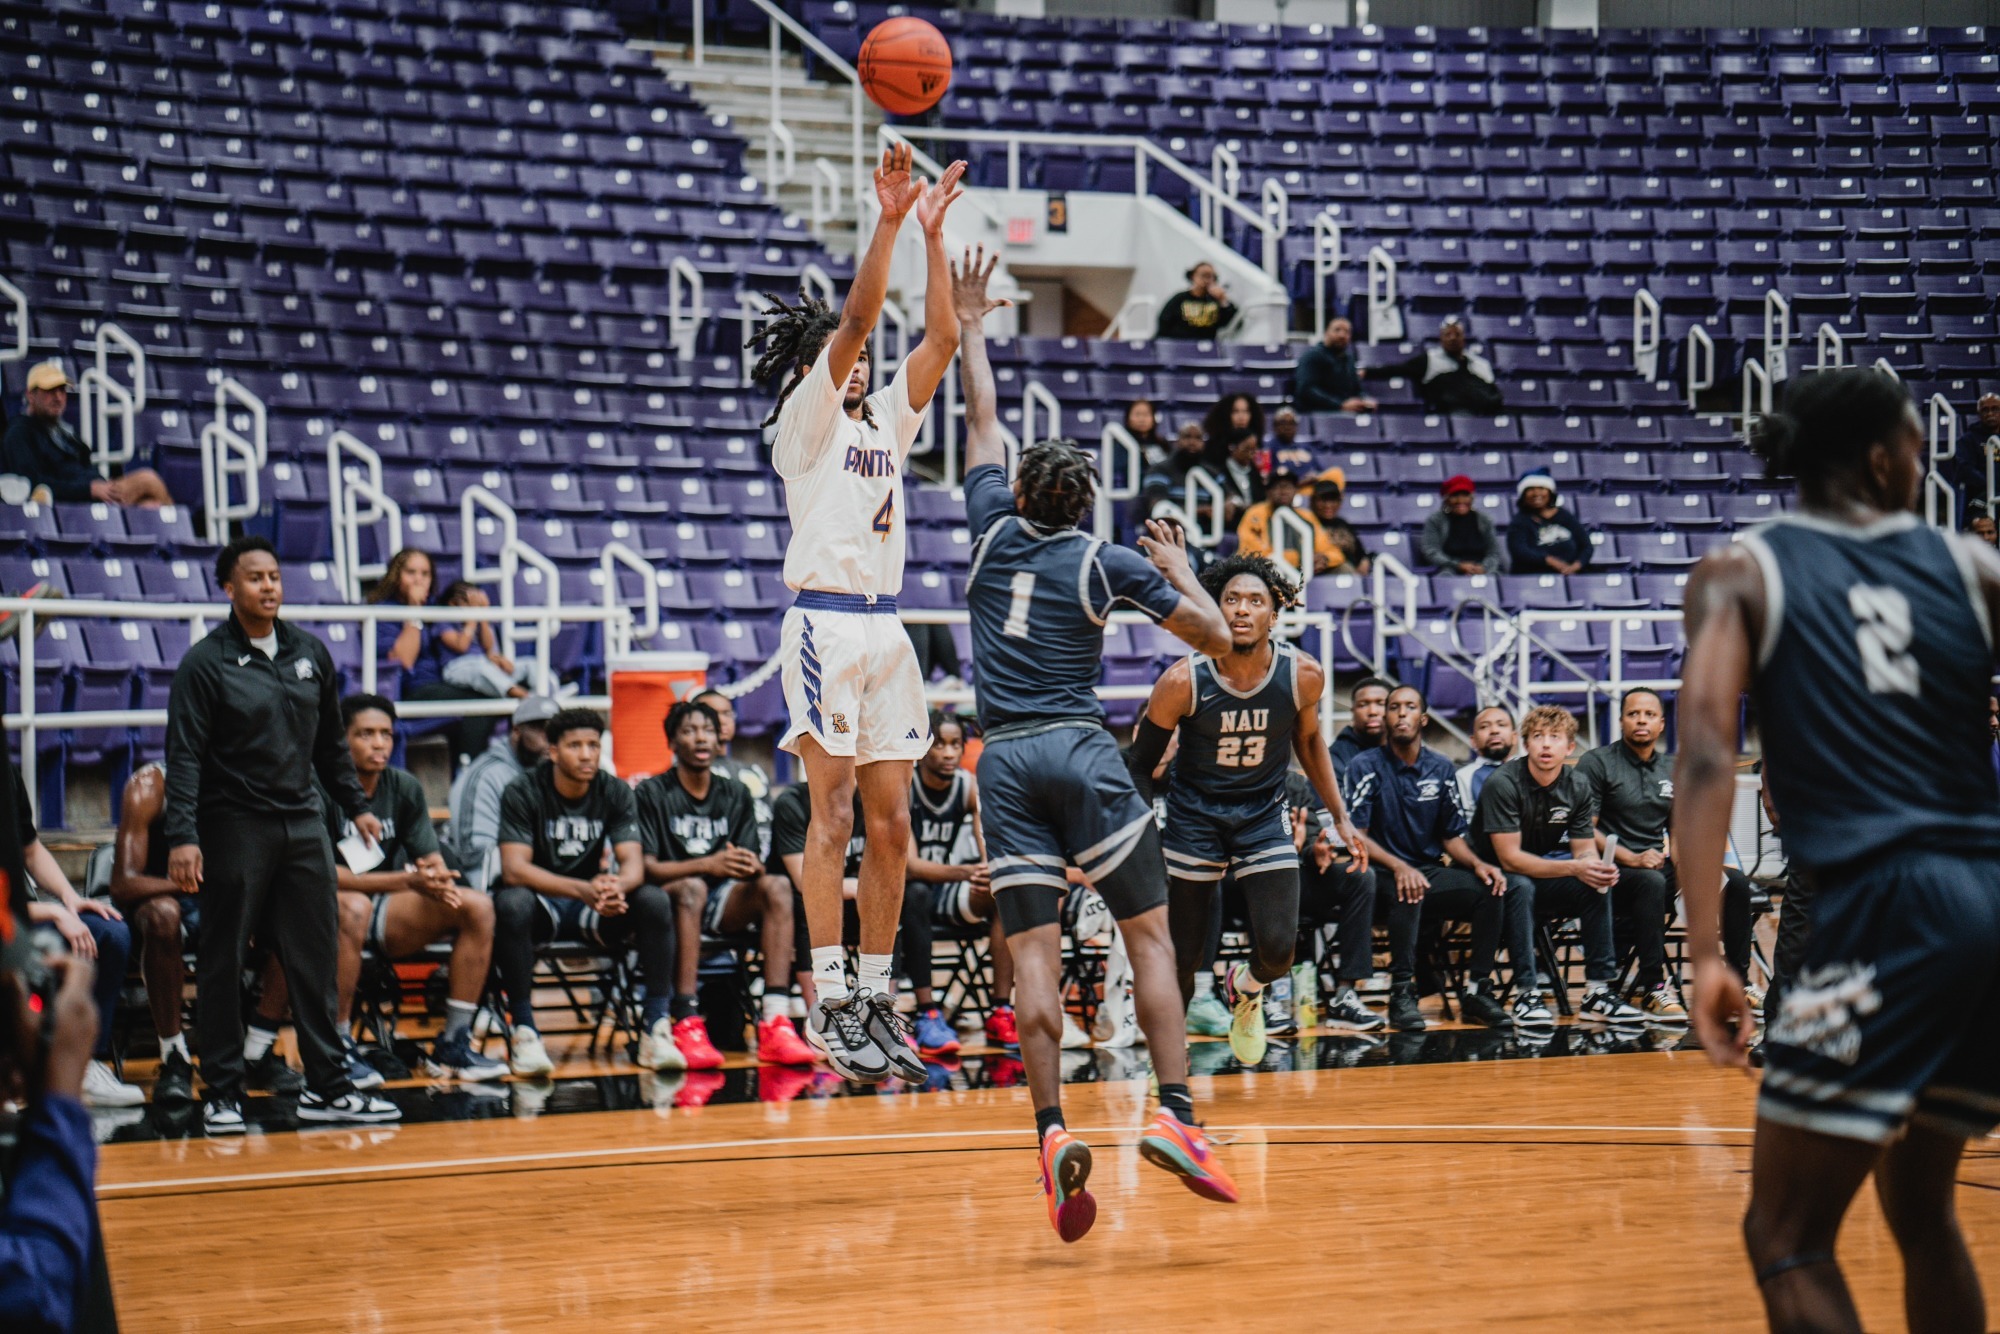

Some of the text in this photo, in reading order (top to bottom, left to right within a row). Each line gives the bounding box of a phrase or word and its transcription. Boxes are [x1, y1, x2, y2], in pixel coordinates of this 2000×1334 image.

[1049, 200, 1066, 226] 3
[872, 487, 893, 543] 4
[1002, 571, 1036, 639] 1
[1848, 582, 1920, 699] 2
[1220, 708, 1269, 733] NAU
[1216, 736, 1267, 768] 23
